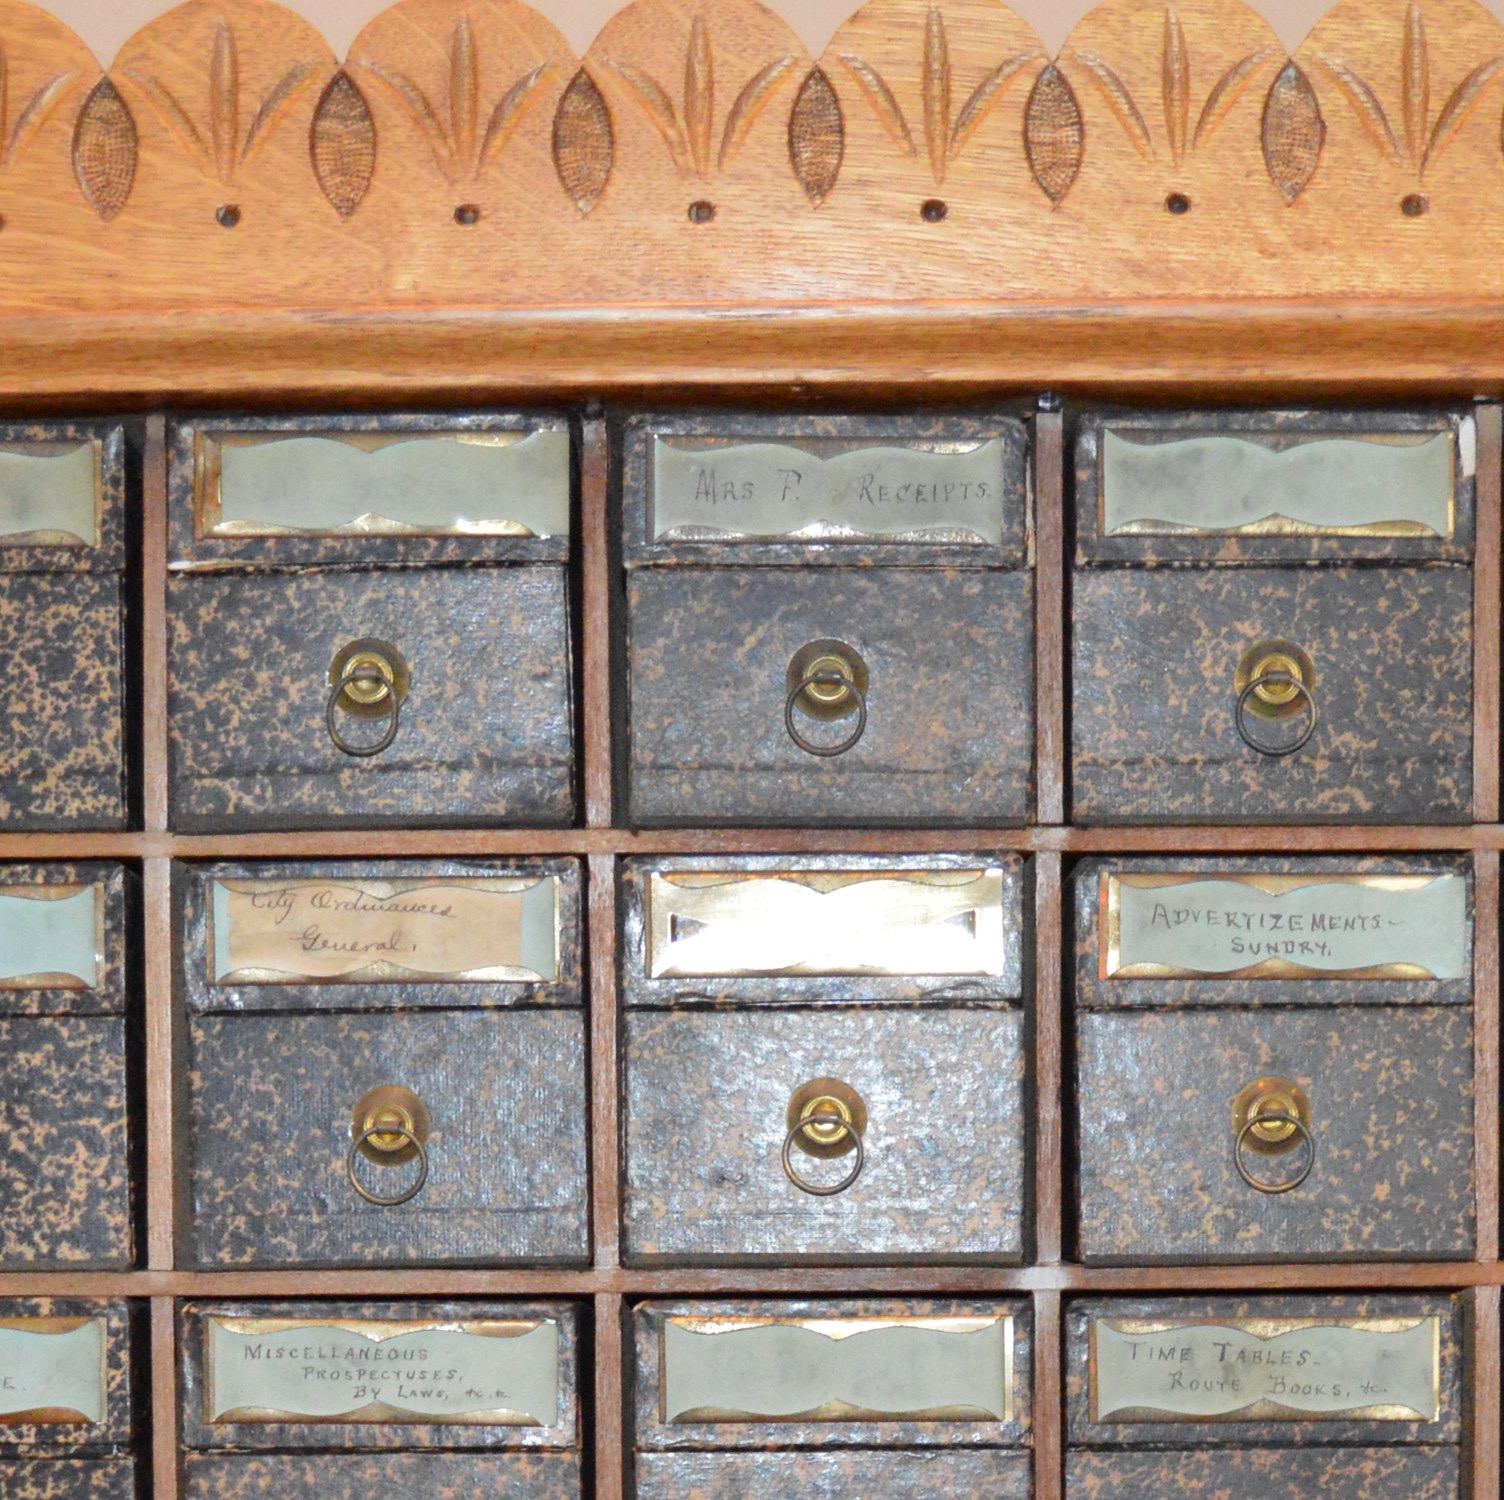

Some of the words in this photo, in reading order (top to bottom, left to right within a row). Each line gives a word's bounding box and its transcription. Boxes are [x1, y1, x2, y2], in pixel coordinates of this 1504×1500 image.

[857, 470, 992, 507] RECEIPTS.
[243, 1343, 429, 1362] MISCELLANEOUS
[1123, 1340, 1193, 1363] TIME
[1167, 1370, 1244, 1392] ROUTE
